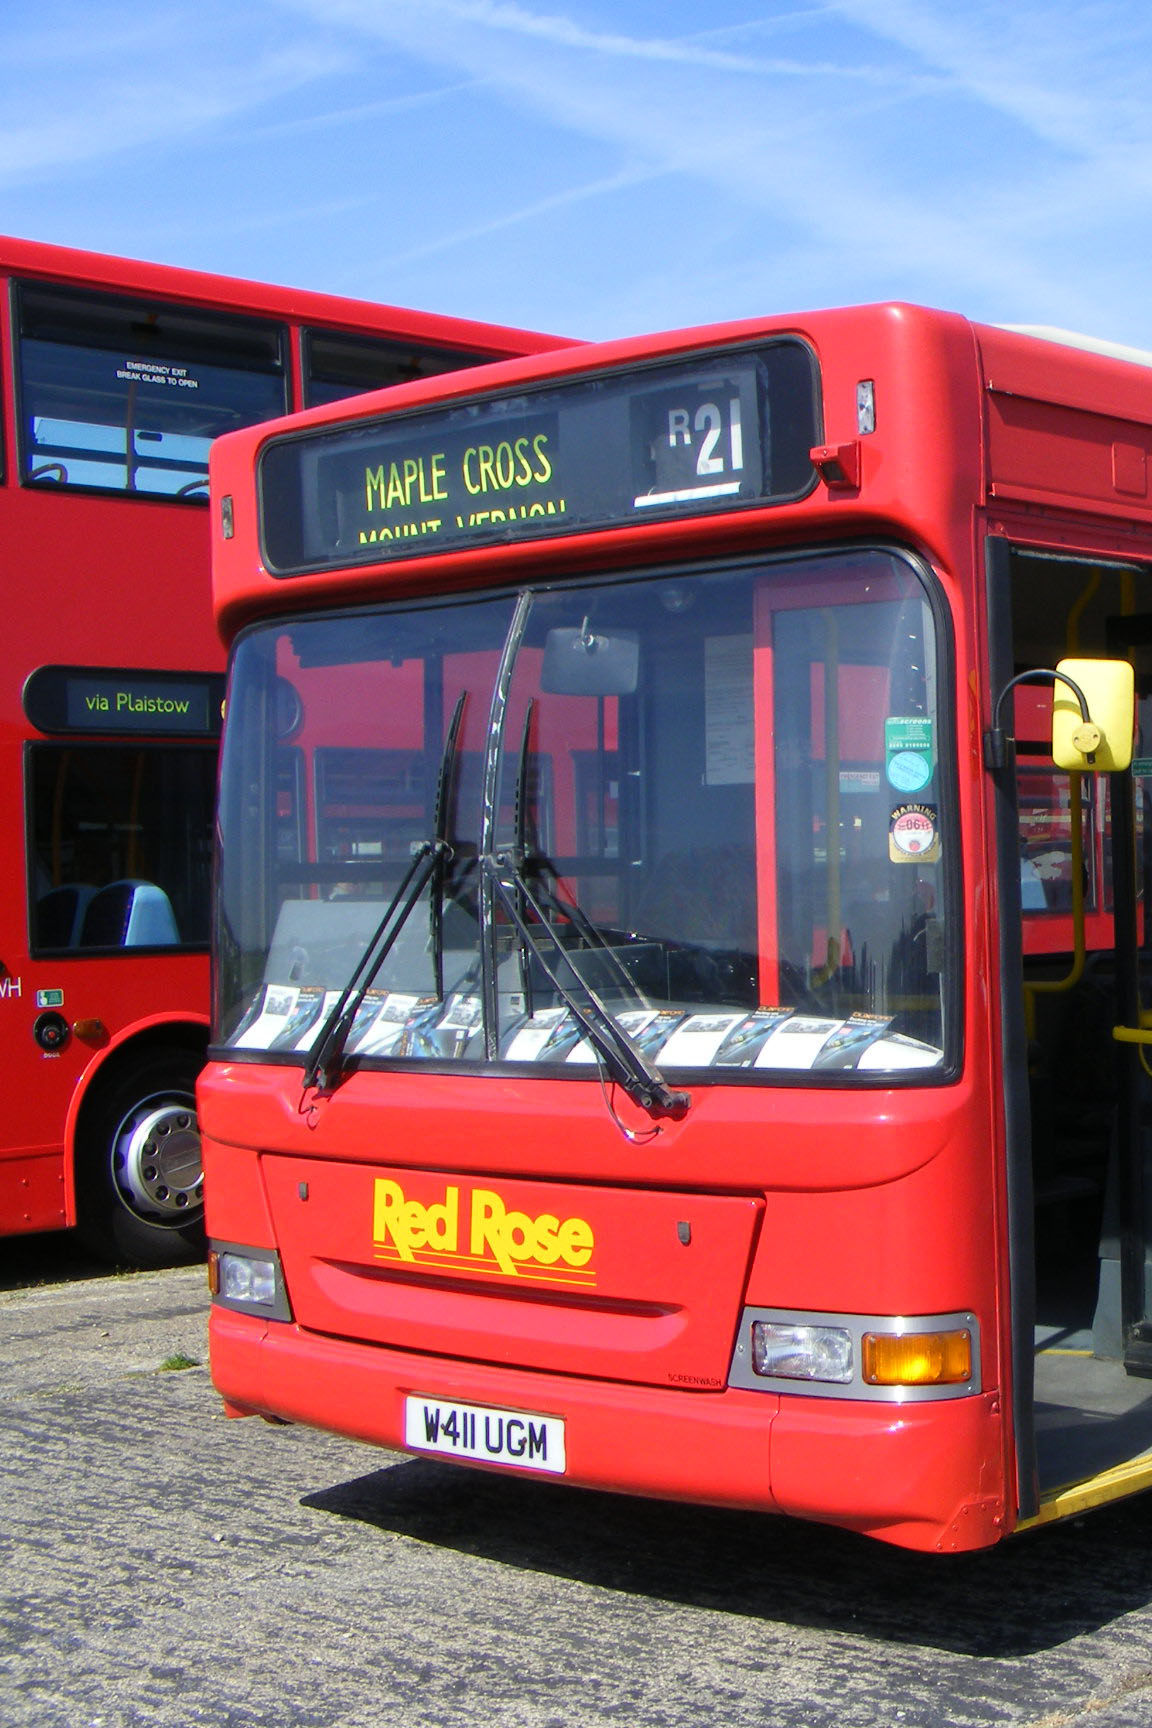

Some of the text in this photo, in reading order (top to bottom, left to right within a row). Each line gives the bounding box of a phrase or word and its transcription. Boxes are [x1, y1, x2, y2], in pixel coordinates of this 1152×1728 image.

[126, 361, 188, 377] EMERGENCY EXIT
[116, 370, 199, 388] BREAK GLASS TO OPEN
[365, 434, 553, 512] MAPLE CROSS
[85, 692, 190, 713] via Plaistow
[891, 803, 937, 821] WARNING
[373, 1178, 595, 1275] Red Rose
[667, 1373, 722, 1387] SCREENWASH
[423, 1405, 547, 1462] W411 UGM
